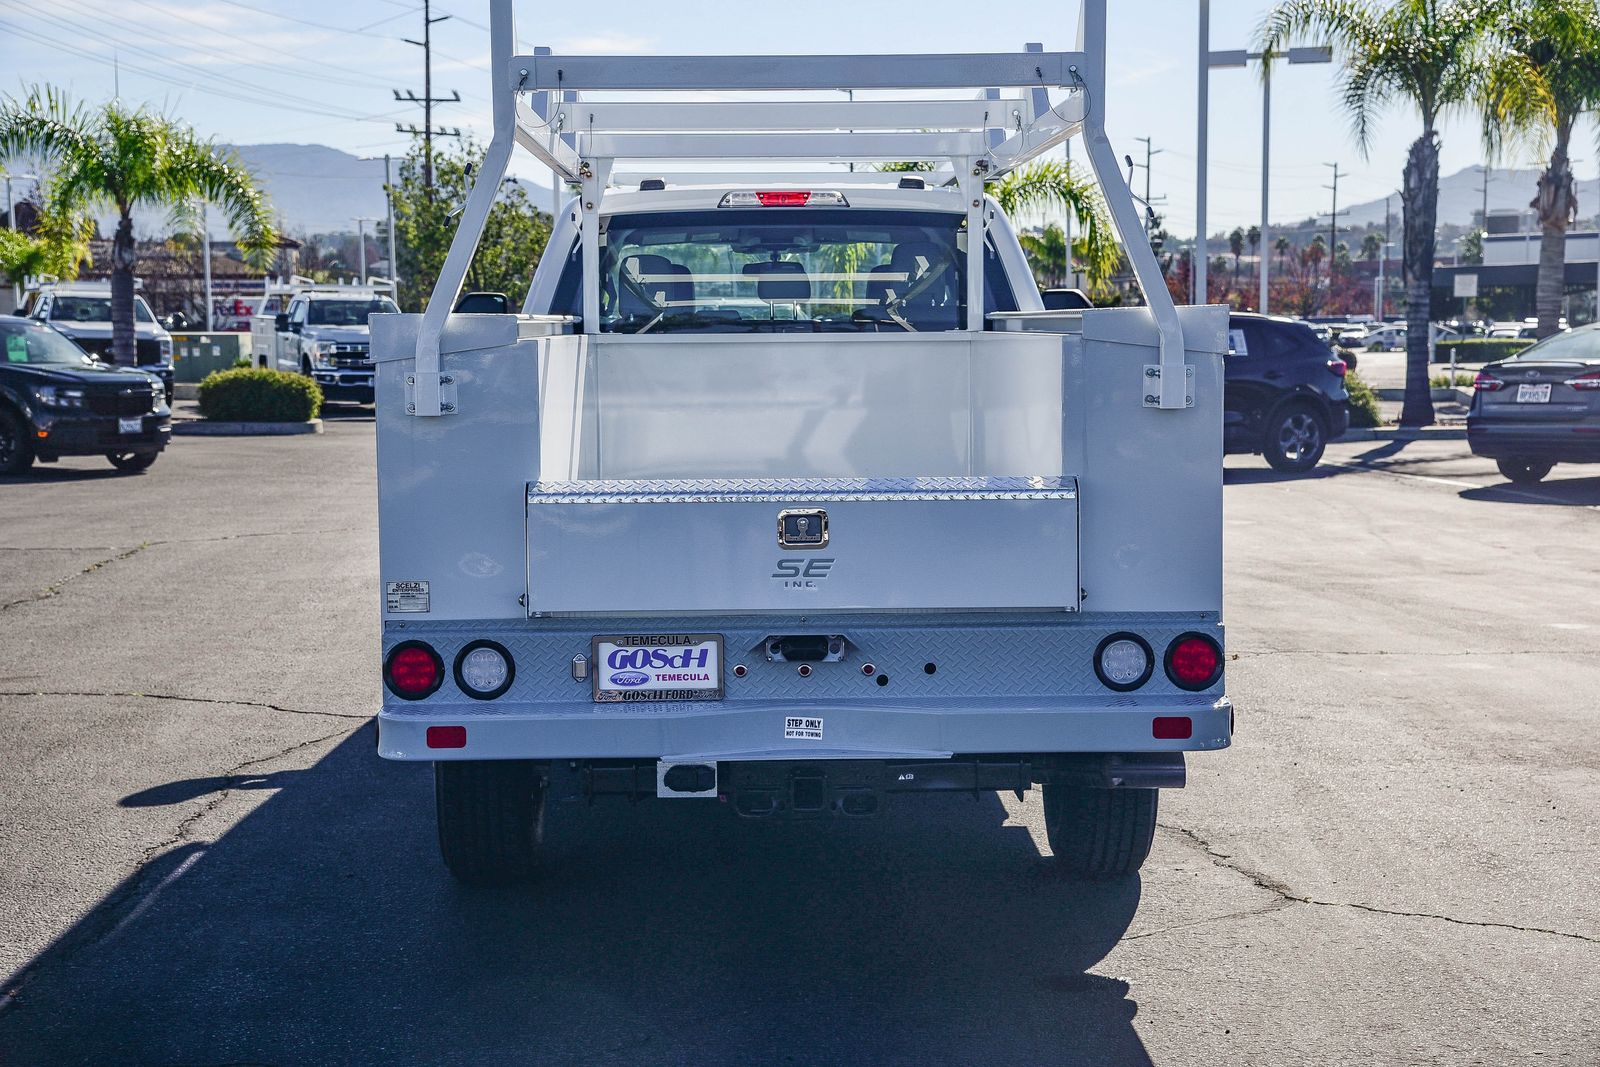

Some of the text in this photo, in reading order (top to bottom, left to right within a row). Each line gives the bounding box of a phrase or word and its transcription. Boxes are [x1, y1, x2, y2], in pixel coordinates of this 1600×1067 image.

[771, 558, 836, 578] SE
[784, 580, 817, 588] INC.
[624, 635, 692, 646] TEMECULA
[616, 673, 644, 685] Ford
[655, 673, 710, 682] TEMECULA
[665, 689, 694, 700] FORD
[787, 719, 821, 728] STEP ONLY
